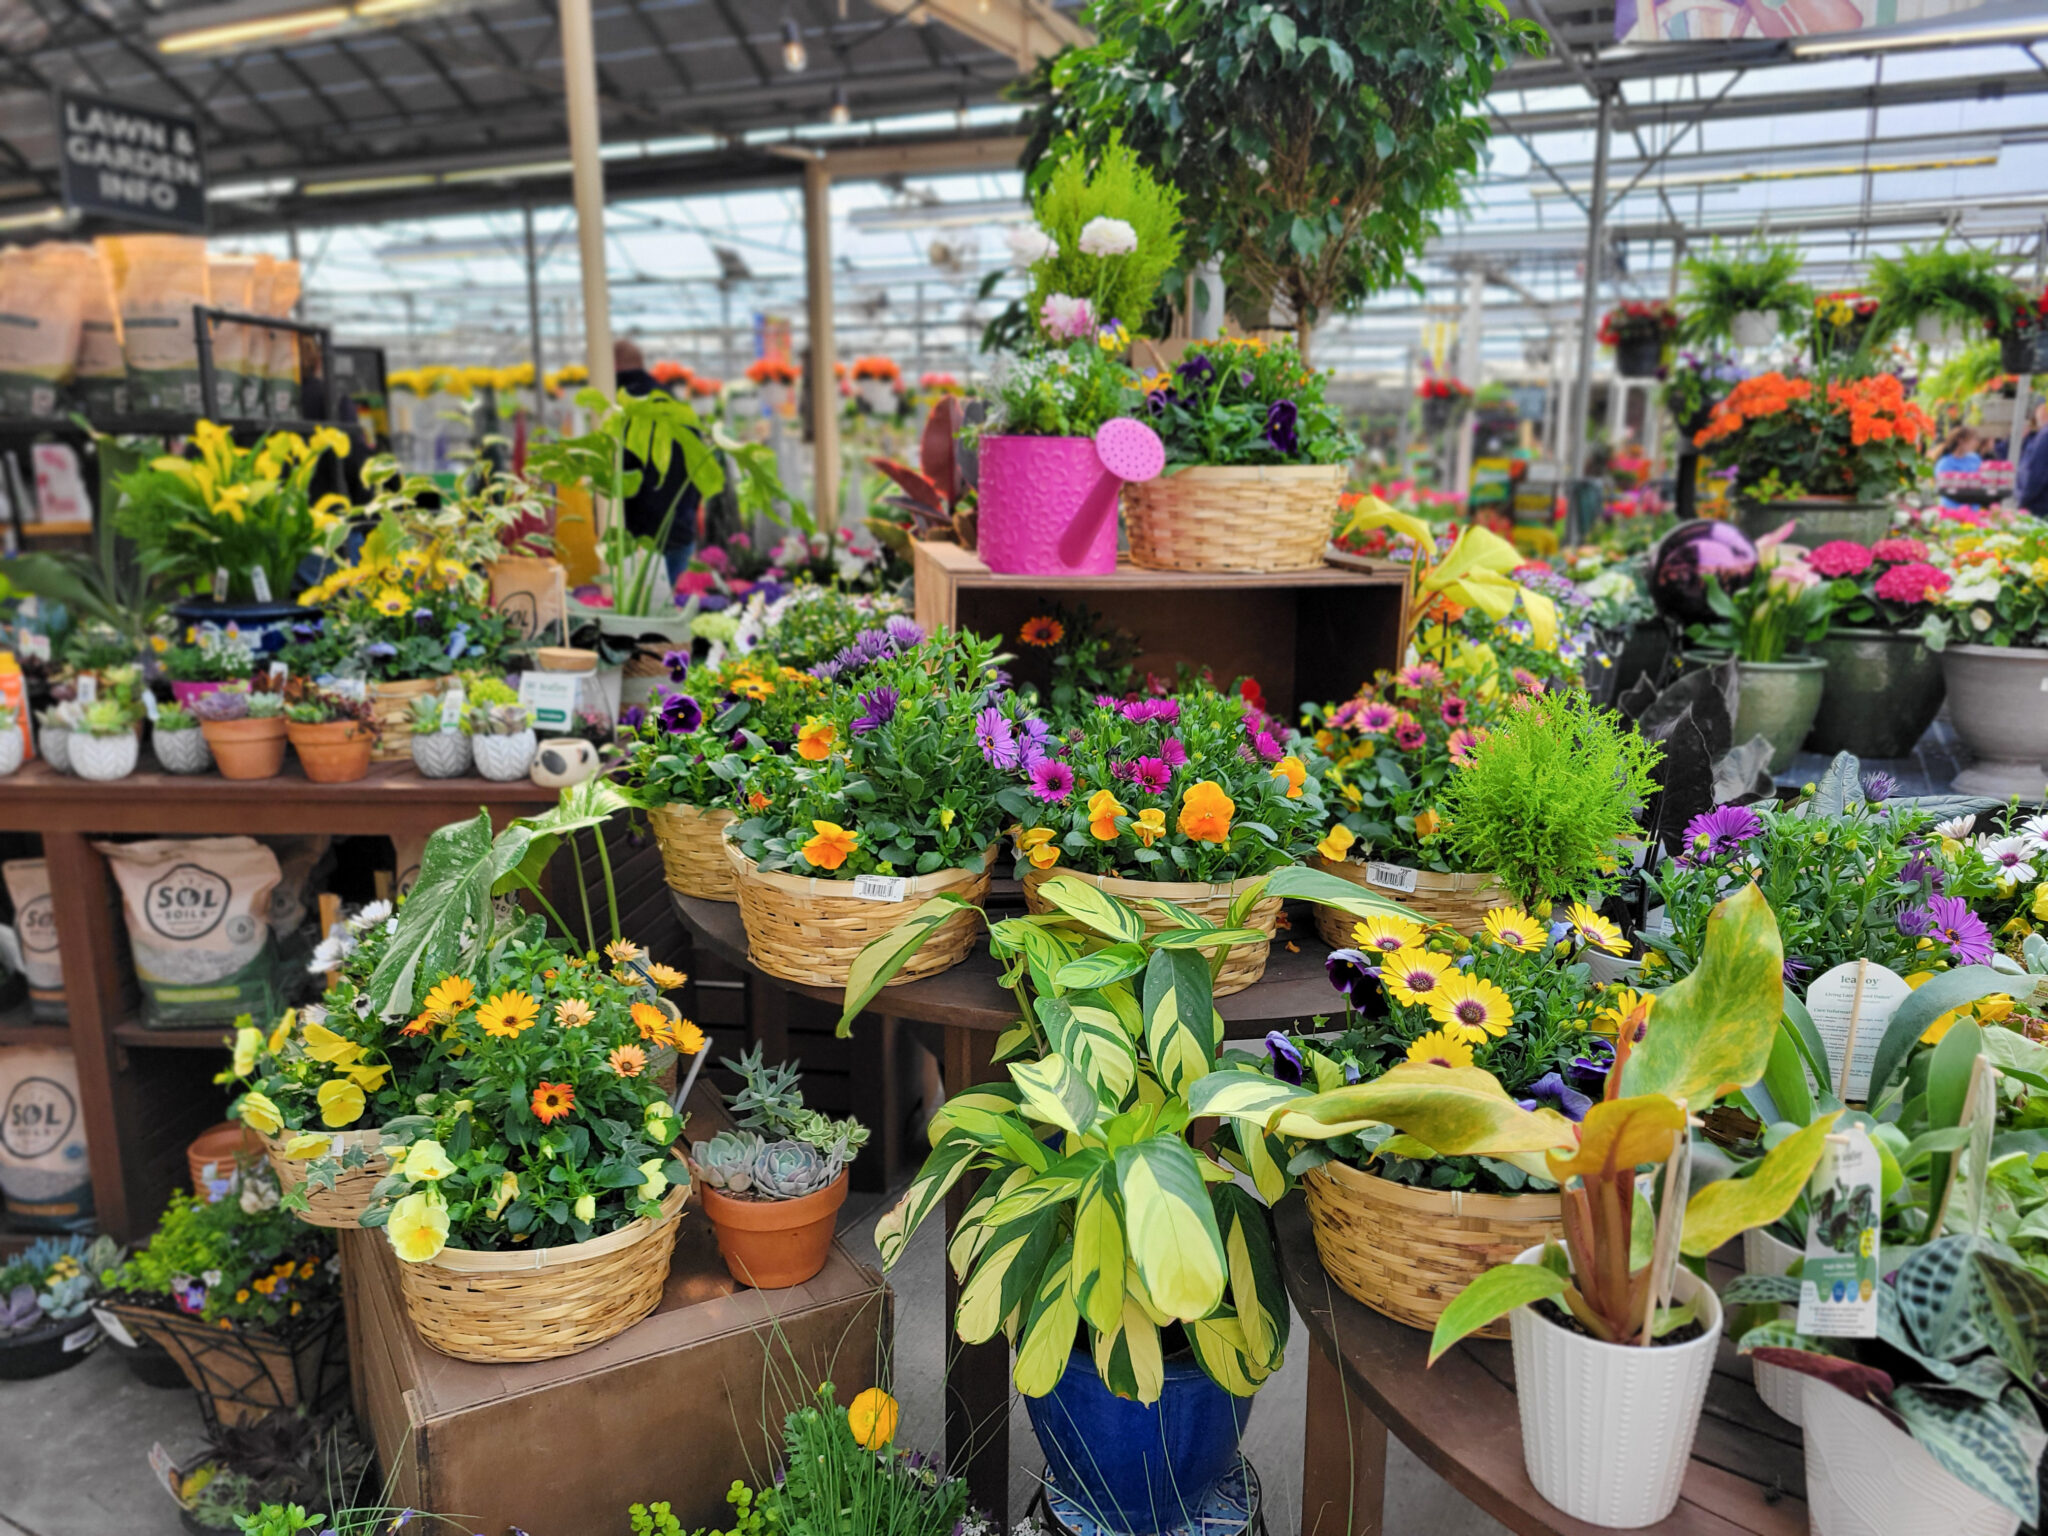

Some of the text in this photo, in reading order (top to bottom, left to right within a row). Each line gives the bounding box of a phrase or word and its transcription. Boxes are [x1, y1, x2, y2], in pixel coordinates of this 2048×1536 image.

[66, 101, 195, 155] LAWN &
[67, 134, 200, 187] GARDEN
[99, 170, 178, 211] INFO
[158, 886, 218, 909] SOL
[165, 909, 208, 920] SOILS
[1841, 975, 1879, 987] leaoy
[12, 1103, 61, 1126] SOL
